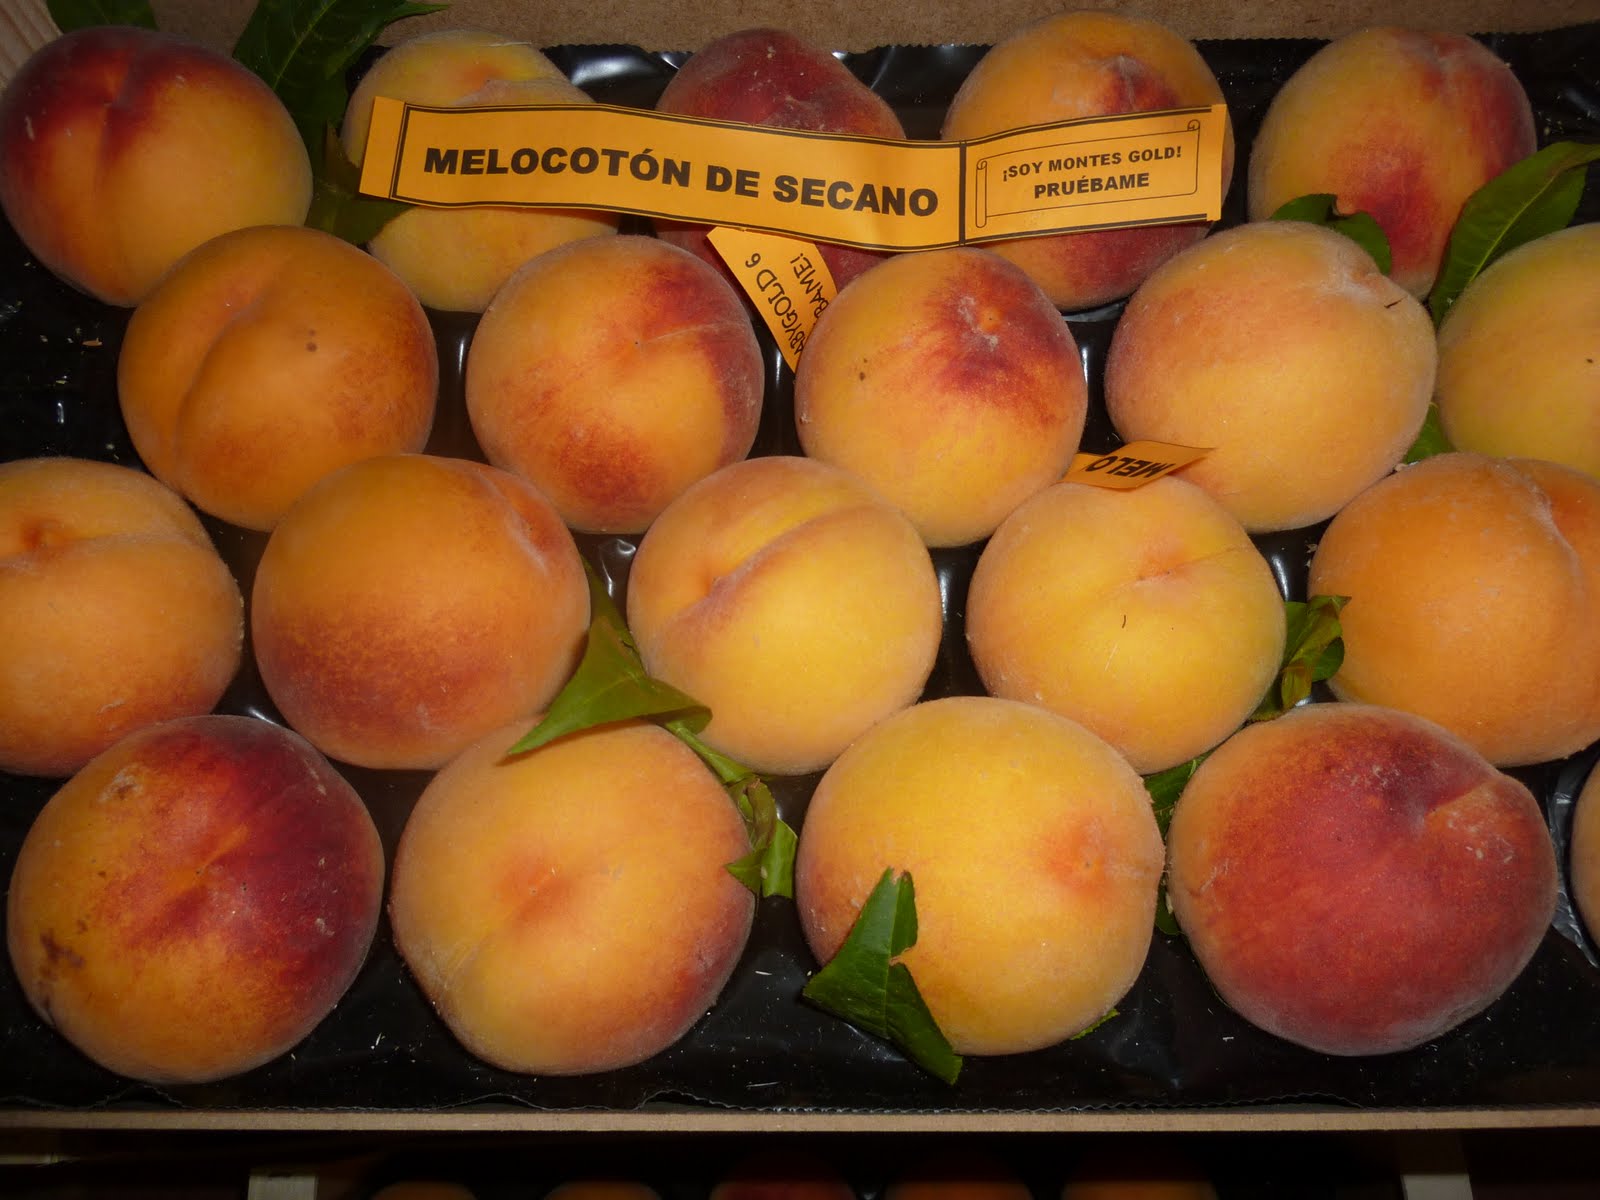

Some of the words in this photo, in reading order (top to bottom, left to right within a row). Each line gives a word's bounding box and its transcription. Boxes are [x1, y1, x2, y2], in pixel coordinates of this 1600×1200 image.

[1002, 161, 1043, 181] ¡SOY
[1048, 153, 1122, 172] MONTES
[1128, 146, 1182, 162] GOLD!
[424, 147, 691, 187] MELOCOTÓN
[706, 165, 760, 198] DE
[773, 175, 939, 217] SECANO
[1034, 172, 1150, 199] PRUÉBAME
[745, 253, 761, 268] 6
[790, 253, 829, 319] BAME!
[756, 269, 806, 355] ABYGOLD
[1083, 455, 1176, 478] MELO
